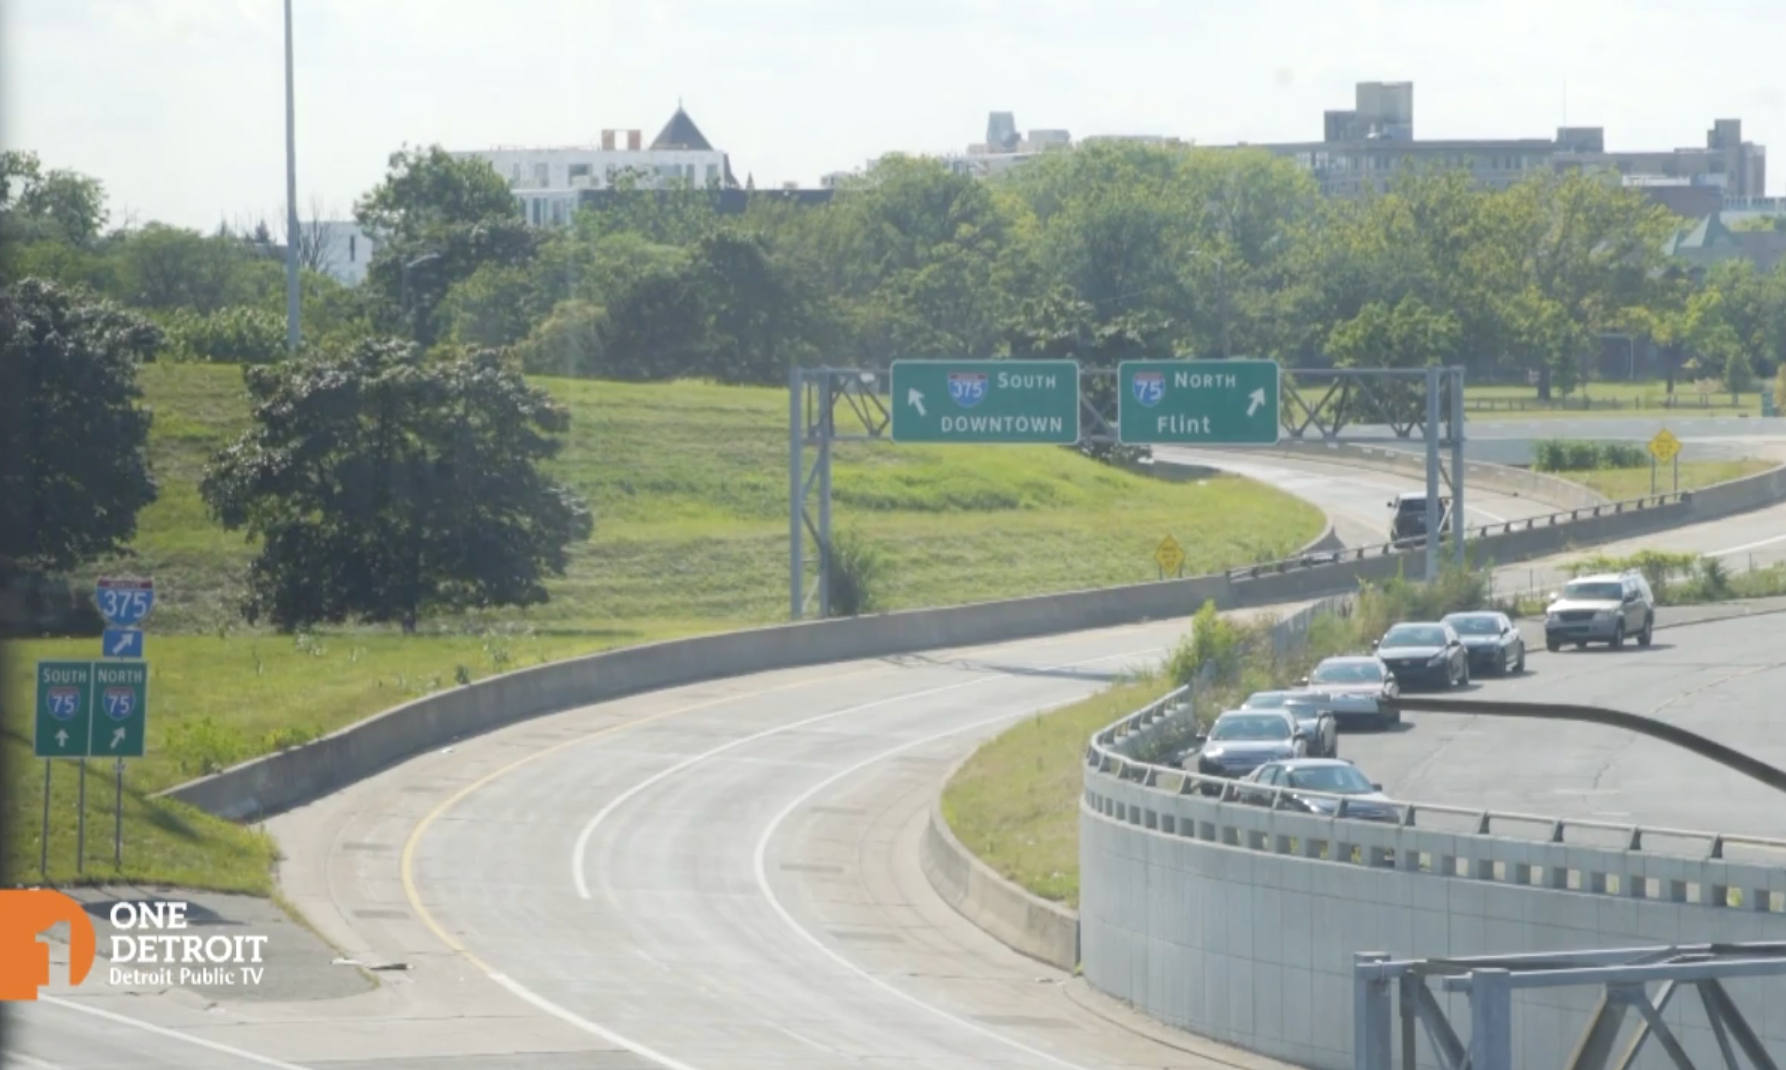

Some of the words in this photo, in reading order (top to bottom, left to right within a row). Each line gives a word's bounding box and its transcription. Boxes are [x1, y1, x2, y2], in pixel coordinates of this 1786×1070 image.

[953, 380, 983, 398] 375
[998, 372, 1057, 389] SOUTH
[1136, 380, 1162, 400] 75
[1174, 372, 1237, 388] NORTH
[941, 416, 1063, 433] DOWNTOWN
[1157, 415, 1211, 434] Flint
[103, 590, 147, 618] 375
[43, 668, 87, 683] SOUTH
[97, 669, 142, 683] NORTH
[53, 696, 74, 714] 75
[108, 696, 130, 714] 75
